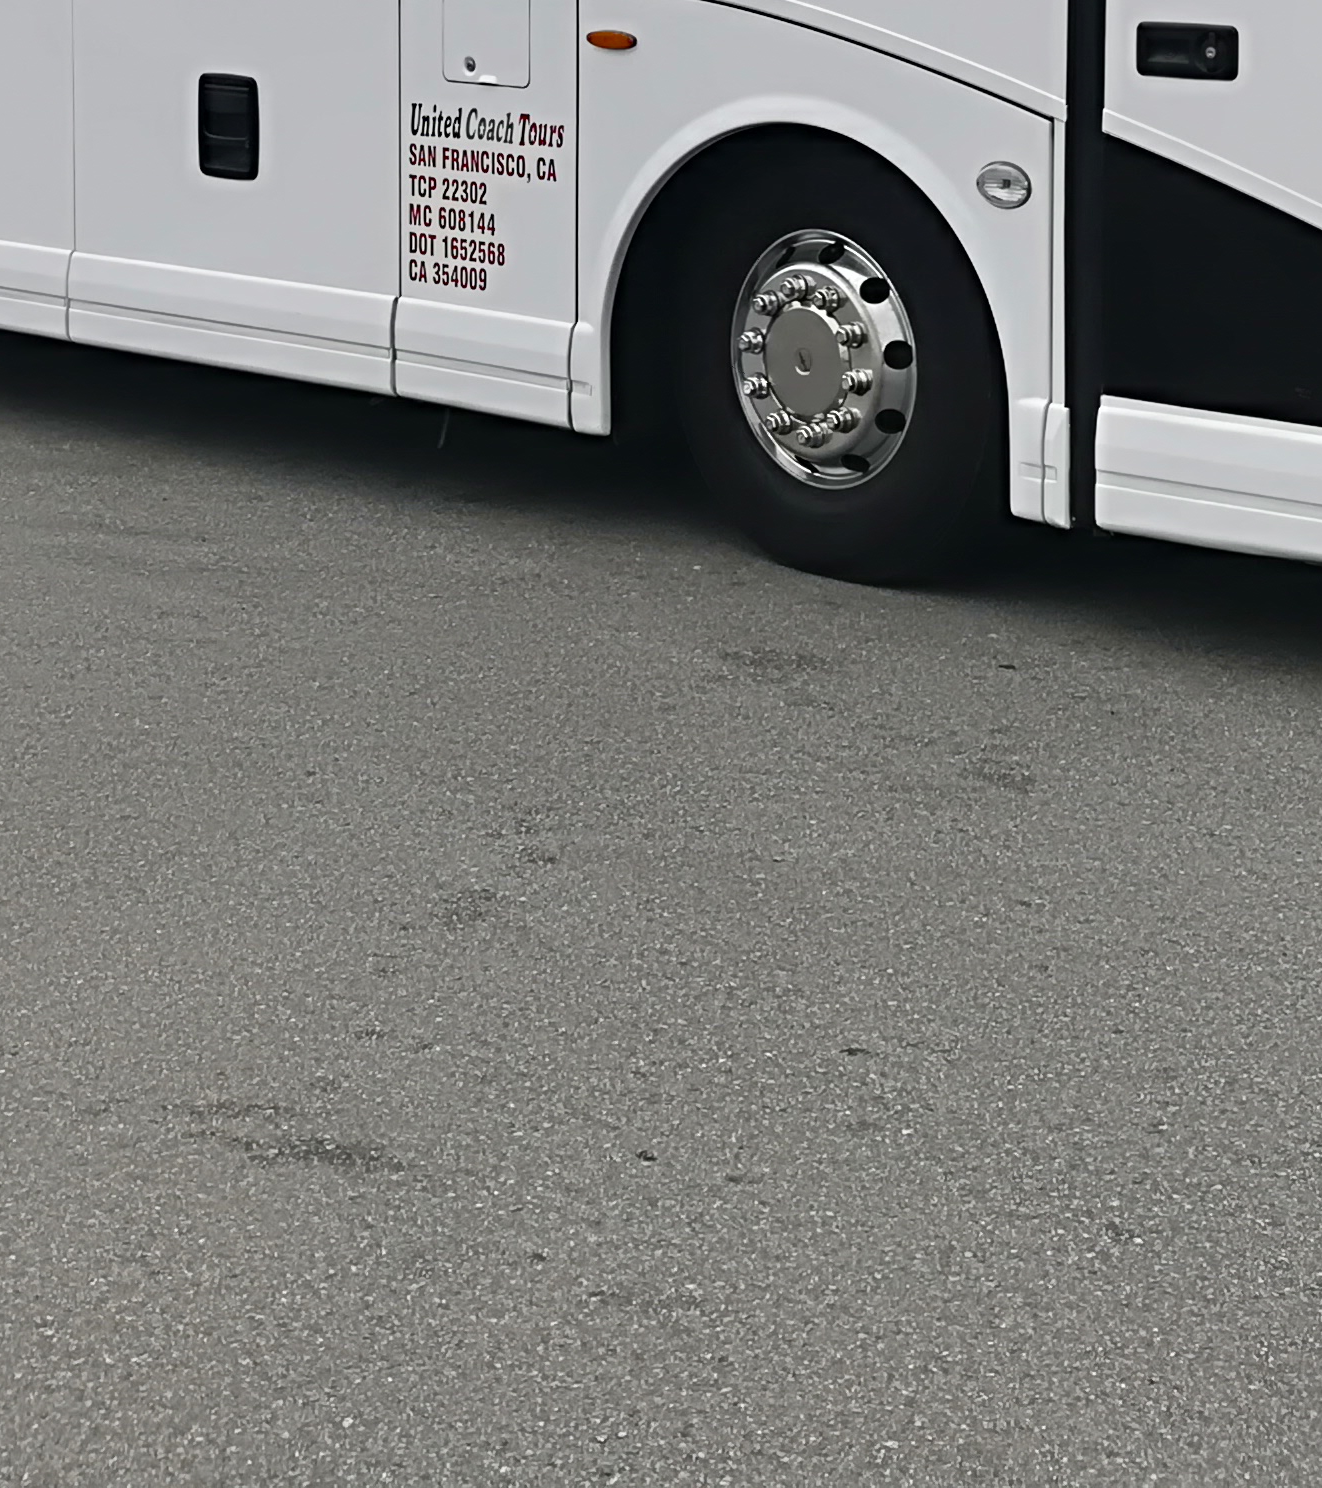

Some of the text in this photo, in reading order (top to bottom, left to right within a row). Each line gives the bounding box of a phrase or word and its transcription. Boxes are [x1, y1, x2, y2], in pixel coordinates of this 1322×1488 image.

[411, 103, 564, 147] United Coach Tours
[409, 144, 557, 183] SAN FRANCISCO, CA
[409, 175, 487, 205] TCP 22302
[409, 204, 495, 236] MC 608144
[409, 232, 505, 266] DOT 1652568
[409, 260, 487, 290] CA 354009
